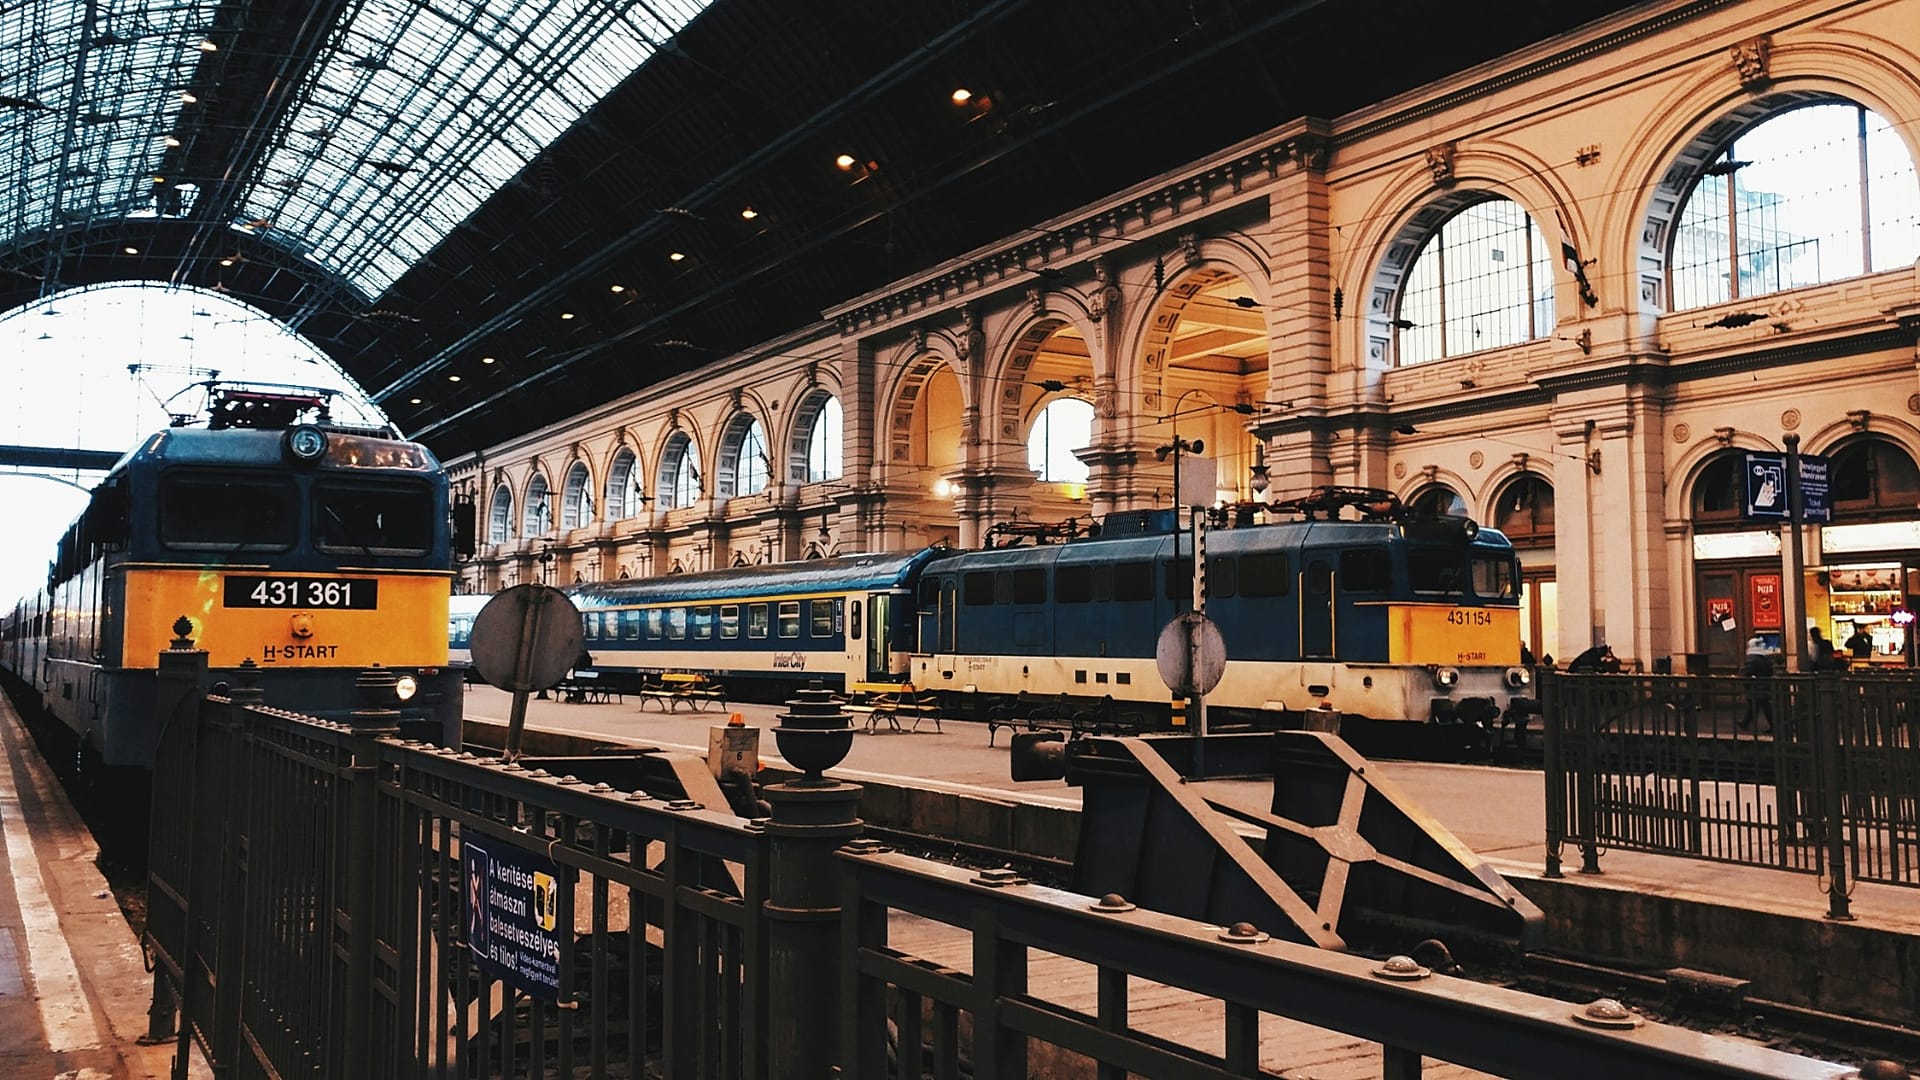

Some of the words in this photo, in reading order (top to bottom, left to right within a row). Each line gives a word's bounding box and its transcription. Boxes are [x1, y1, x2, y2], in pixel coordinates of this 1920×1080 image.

[250, 580, 298, 605] 431
[308, 581, 351, 606] 361
[263, 645, 338, 662] H-START
[773, 651, 807, 671] InterCity
[1457, 652, 1486, 663] H-START
[736, 751, 743, 761] 6
[489, 857, 495, 878] A
[489, 885, 526, 917] átmászni
[489, 939, 498, 962] és
[499, 944, 518, 971] tilos!
